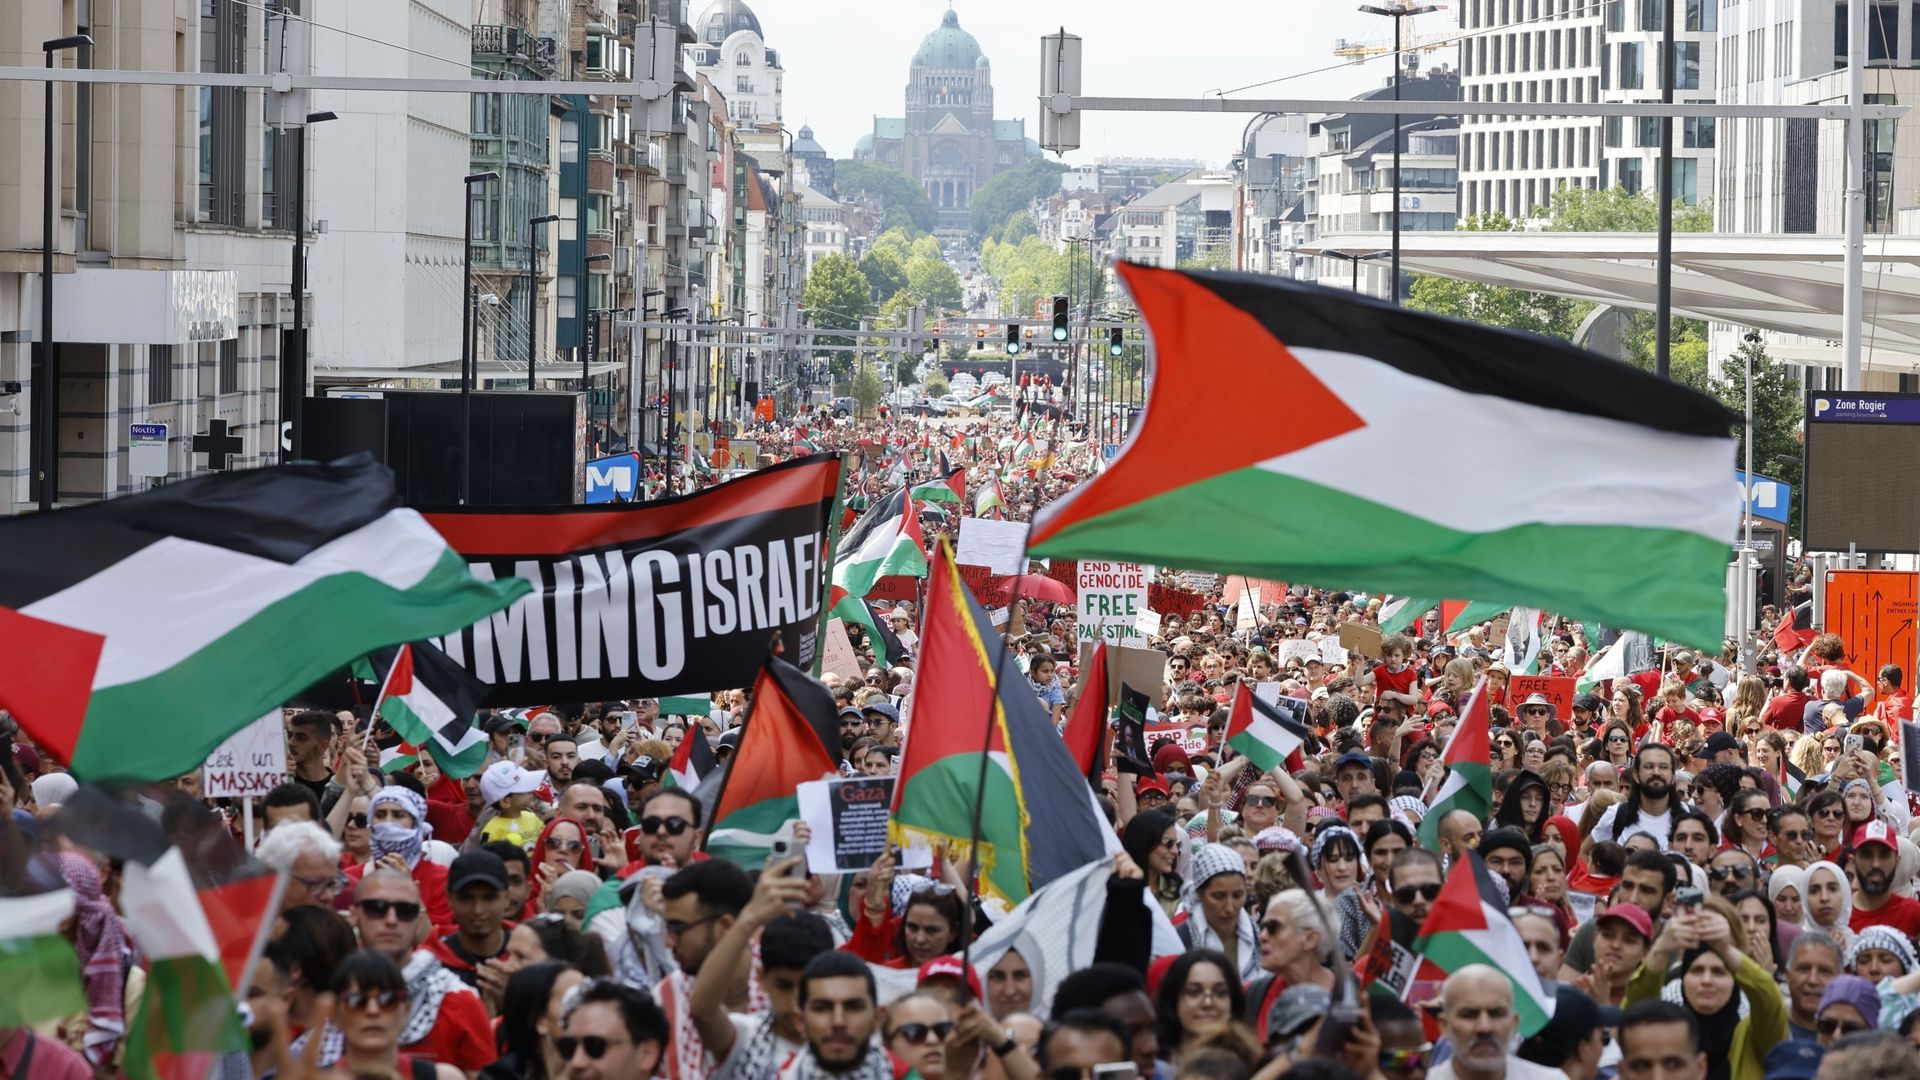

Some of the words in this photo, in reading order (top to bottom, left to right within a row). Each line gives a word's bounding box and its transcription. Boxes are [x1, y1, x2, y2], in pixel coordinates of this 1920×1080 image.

[1836, 399, 1856, 409] Zone
[1859, 400, 1886, 412] Rogier
[132, 425, 155, 434] Noctis
[1083, 562, 1111, 572] END
[1117, 562, 1142, 572] THE
[687, 531, 820, 638] ISRAEL
[1079, 574, 1144, 589] GENOCIDE
[1085, 593, 1138, 616] FREE
[1519, 680, 1549, 691] FREE
[1148, 731, 1182, 744] Stop
[252, 752, 274, 767] un
[209, 771, 287, 795] MASSACRE
[840, 783, 886, 803] Gaza
